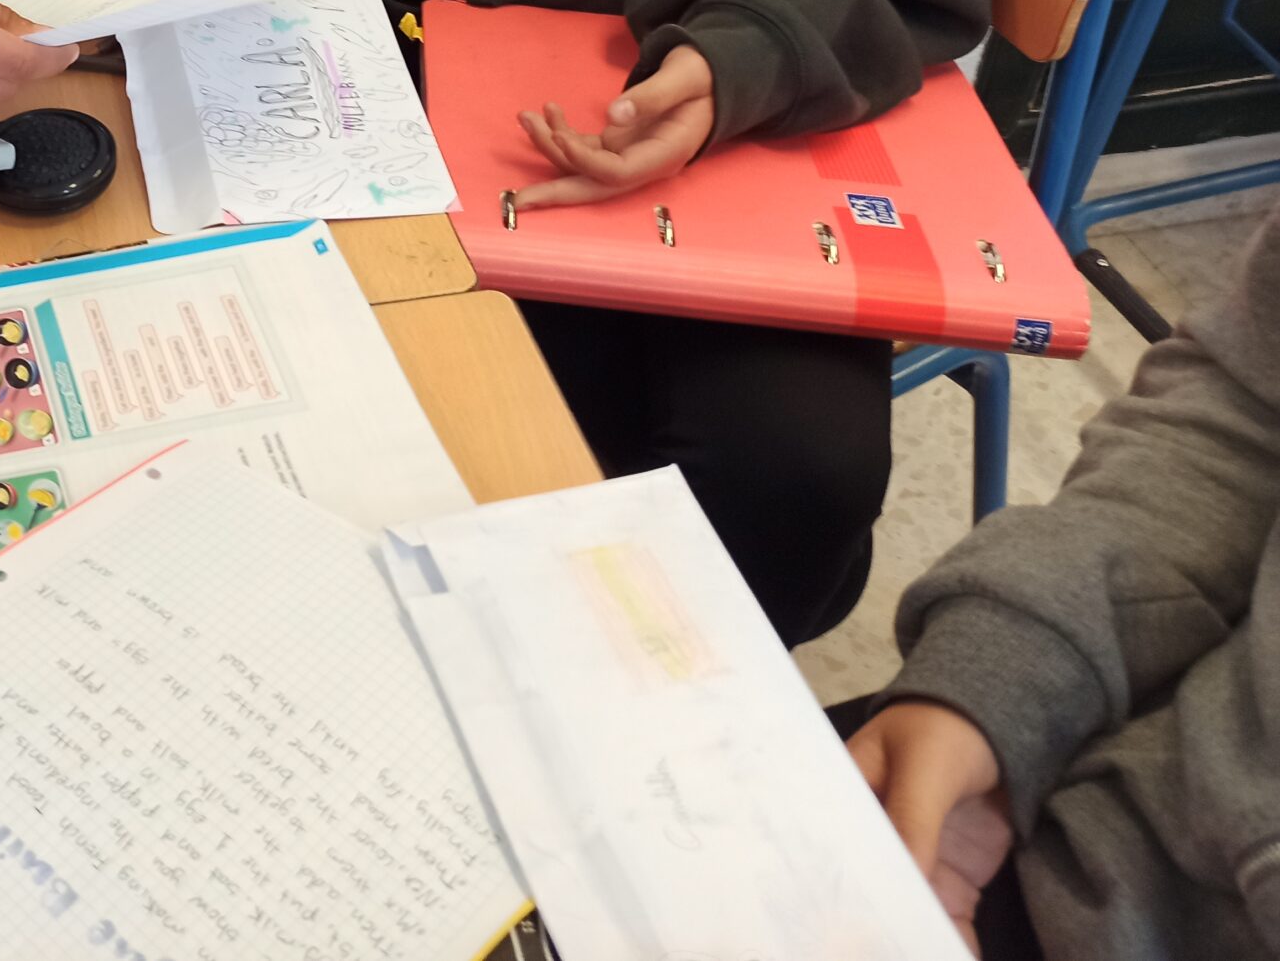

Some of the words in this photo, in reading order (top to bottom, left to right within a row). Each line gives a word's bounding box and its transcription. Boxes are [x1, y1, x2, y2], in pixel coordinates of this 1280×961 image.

[240, 45, 322, 140] CARLA
[76, 556, 115, 579] and
[70, 607, 104, 633] and
[160, 673, 192, 702] the
[216, 652, 264, 694] bread
[0, 687, 41, 717] and
[110, 704, 148, 733] and
[271, 690, 297, 718] the
[200, 703, 243, 742] with
[149, 738, 192, 772] salt
[173, 788, 209, 826] egg
[306, 791, 339, 825] the
[108, 817, 136, 853] the
[158, 827, 203, 862] and
[253, 824, 282, 856] the
[152, 856, 187, 887] you
[240, 855, 272, 889] the
[295, 863, 342, 901] add
[187, 894, 241, 944] show
